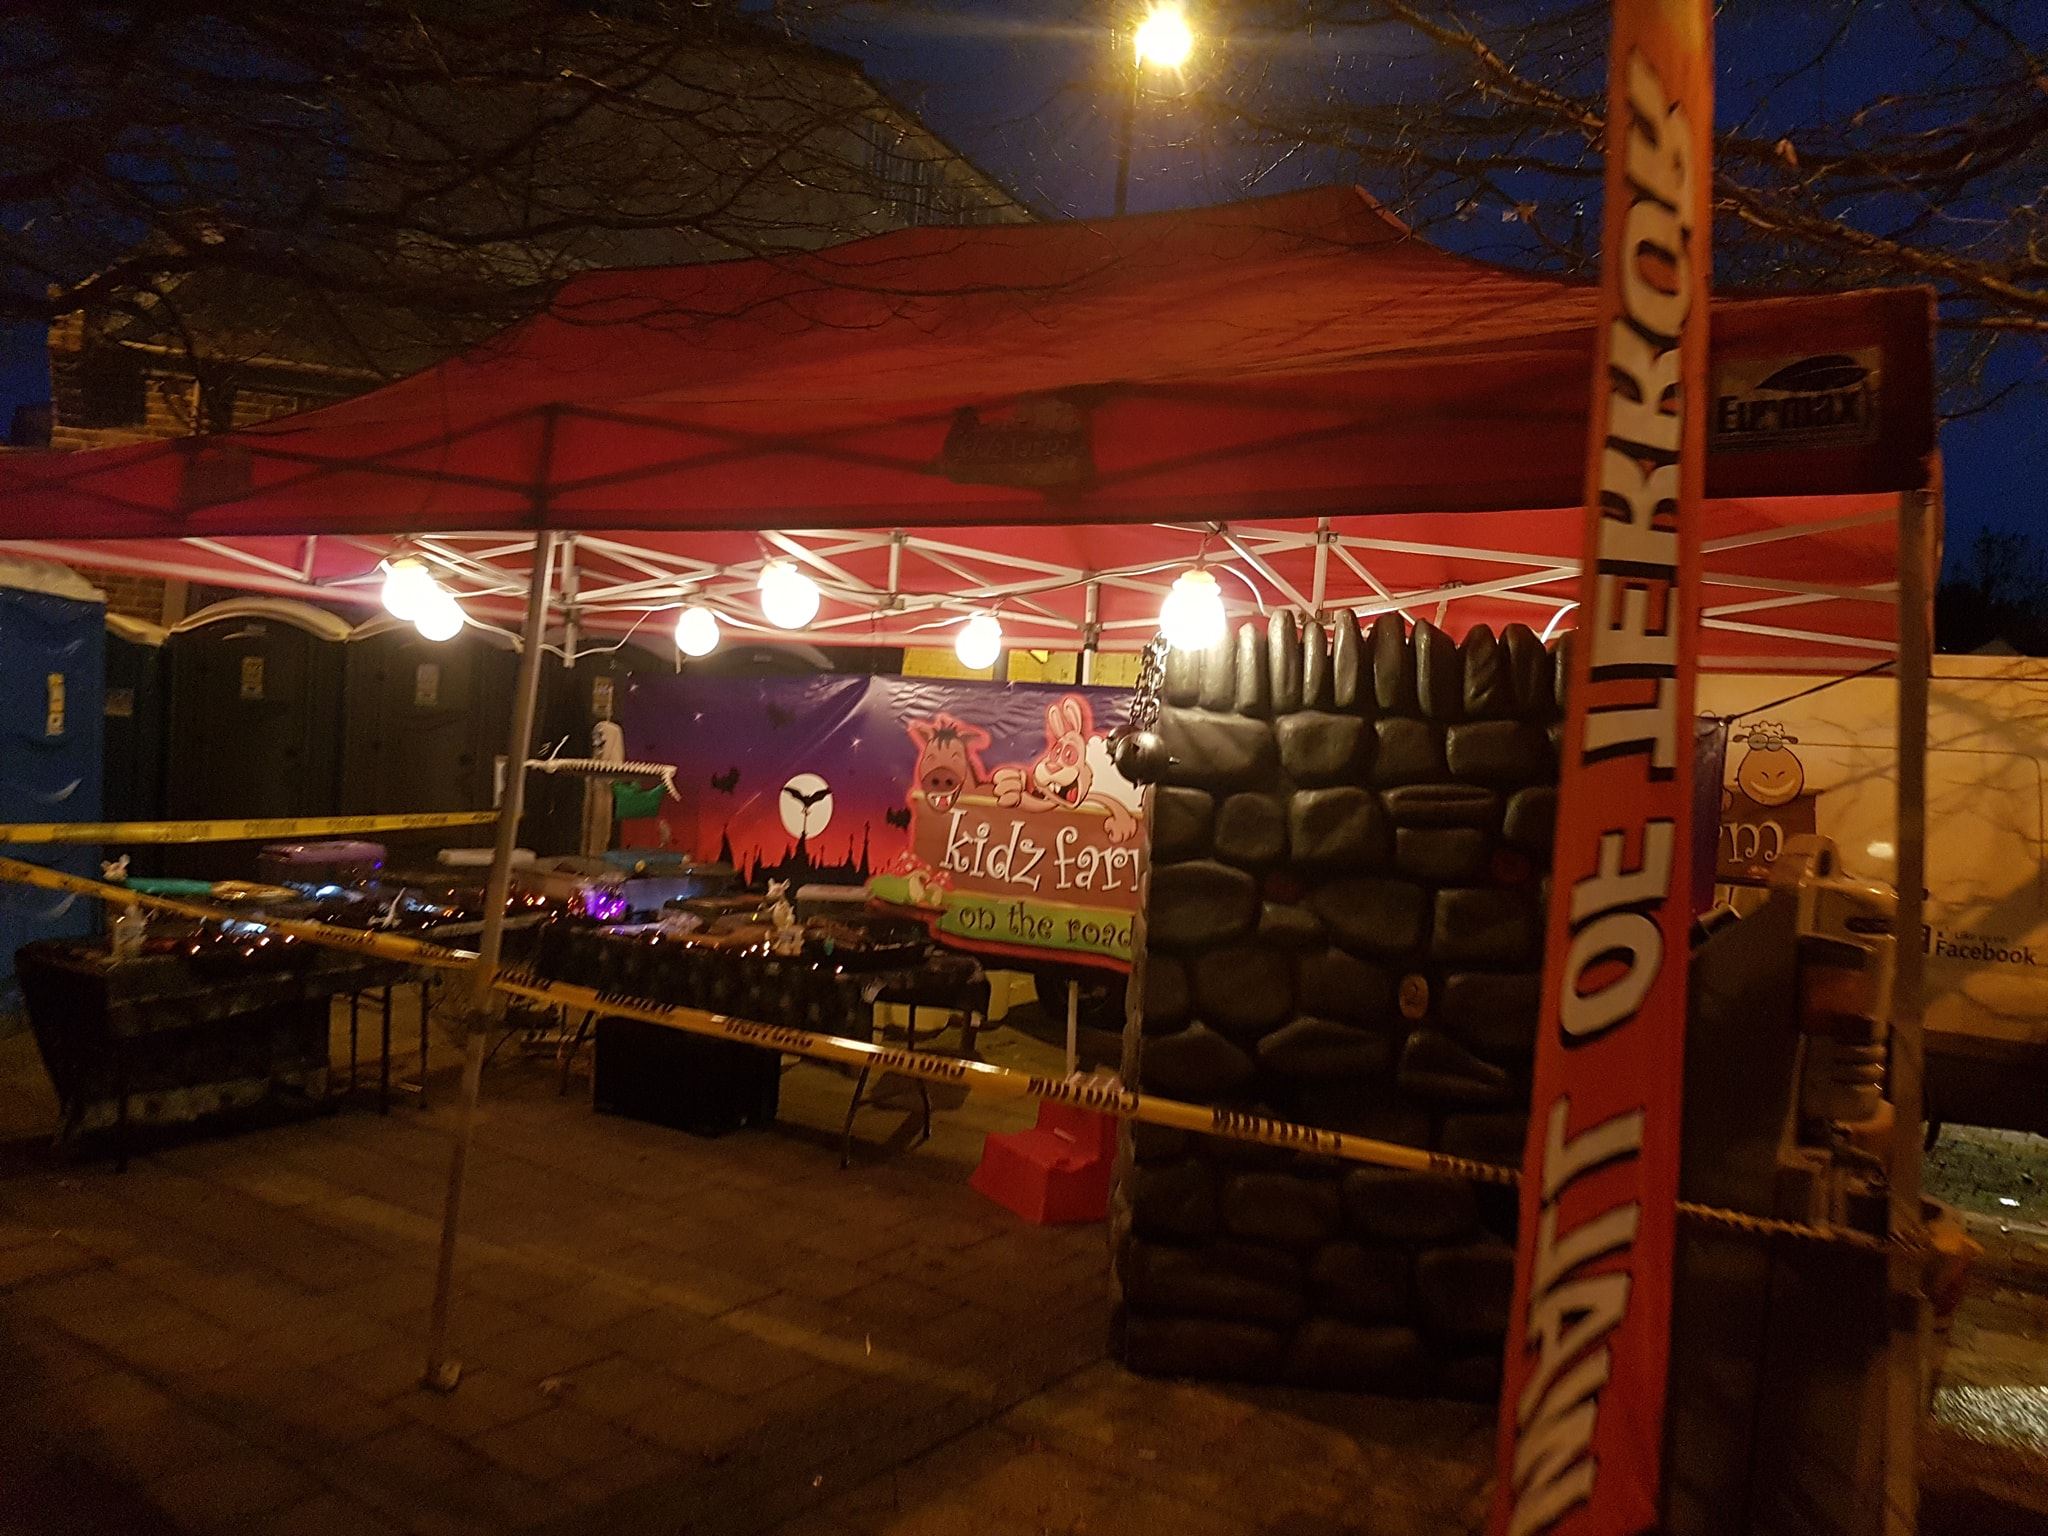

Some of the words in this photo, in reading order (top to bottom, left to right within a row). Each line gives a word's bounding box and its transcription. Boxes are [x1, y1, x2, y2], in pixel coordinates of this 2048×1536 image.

[938, 807, 1047, 893] kidz
[958, 905, 996, 931] on
[1008, 900, 1053, 940] the
[1066, 914, 1136, 948] road
[1934, 939, 2037, 966] Facebook
